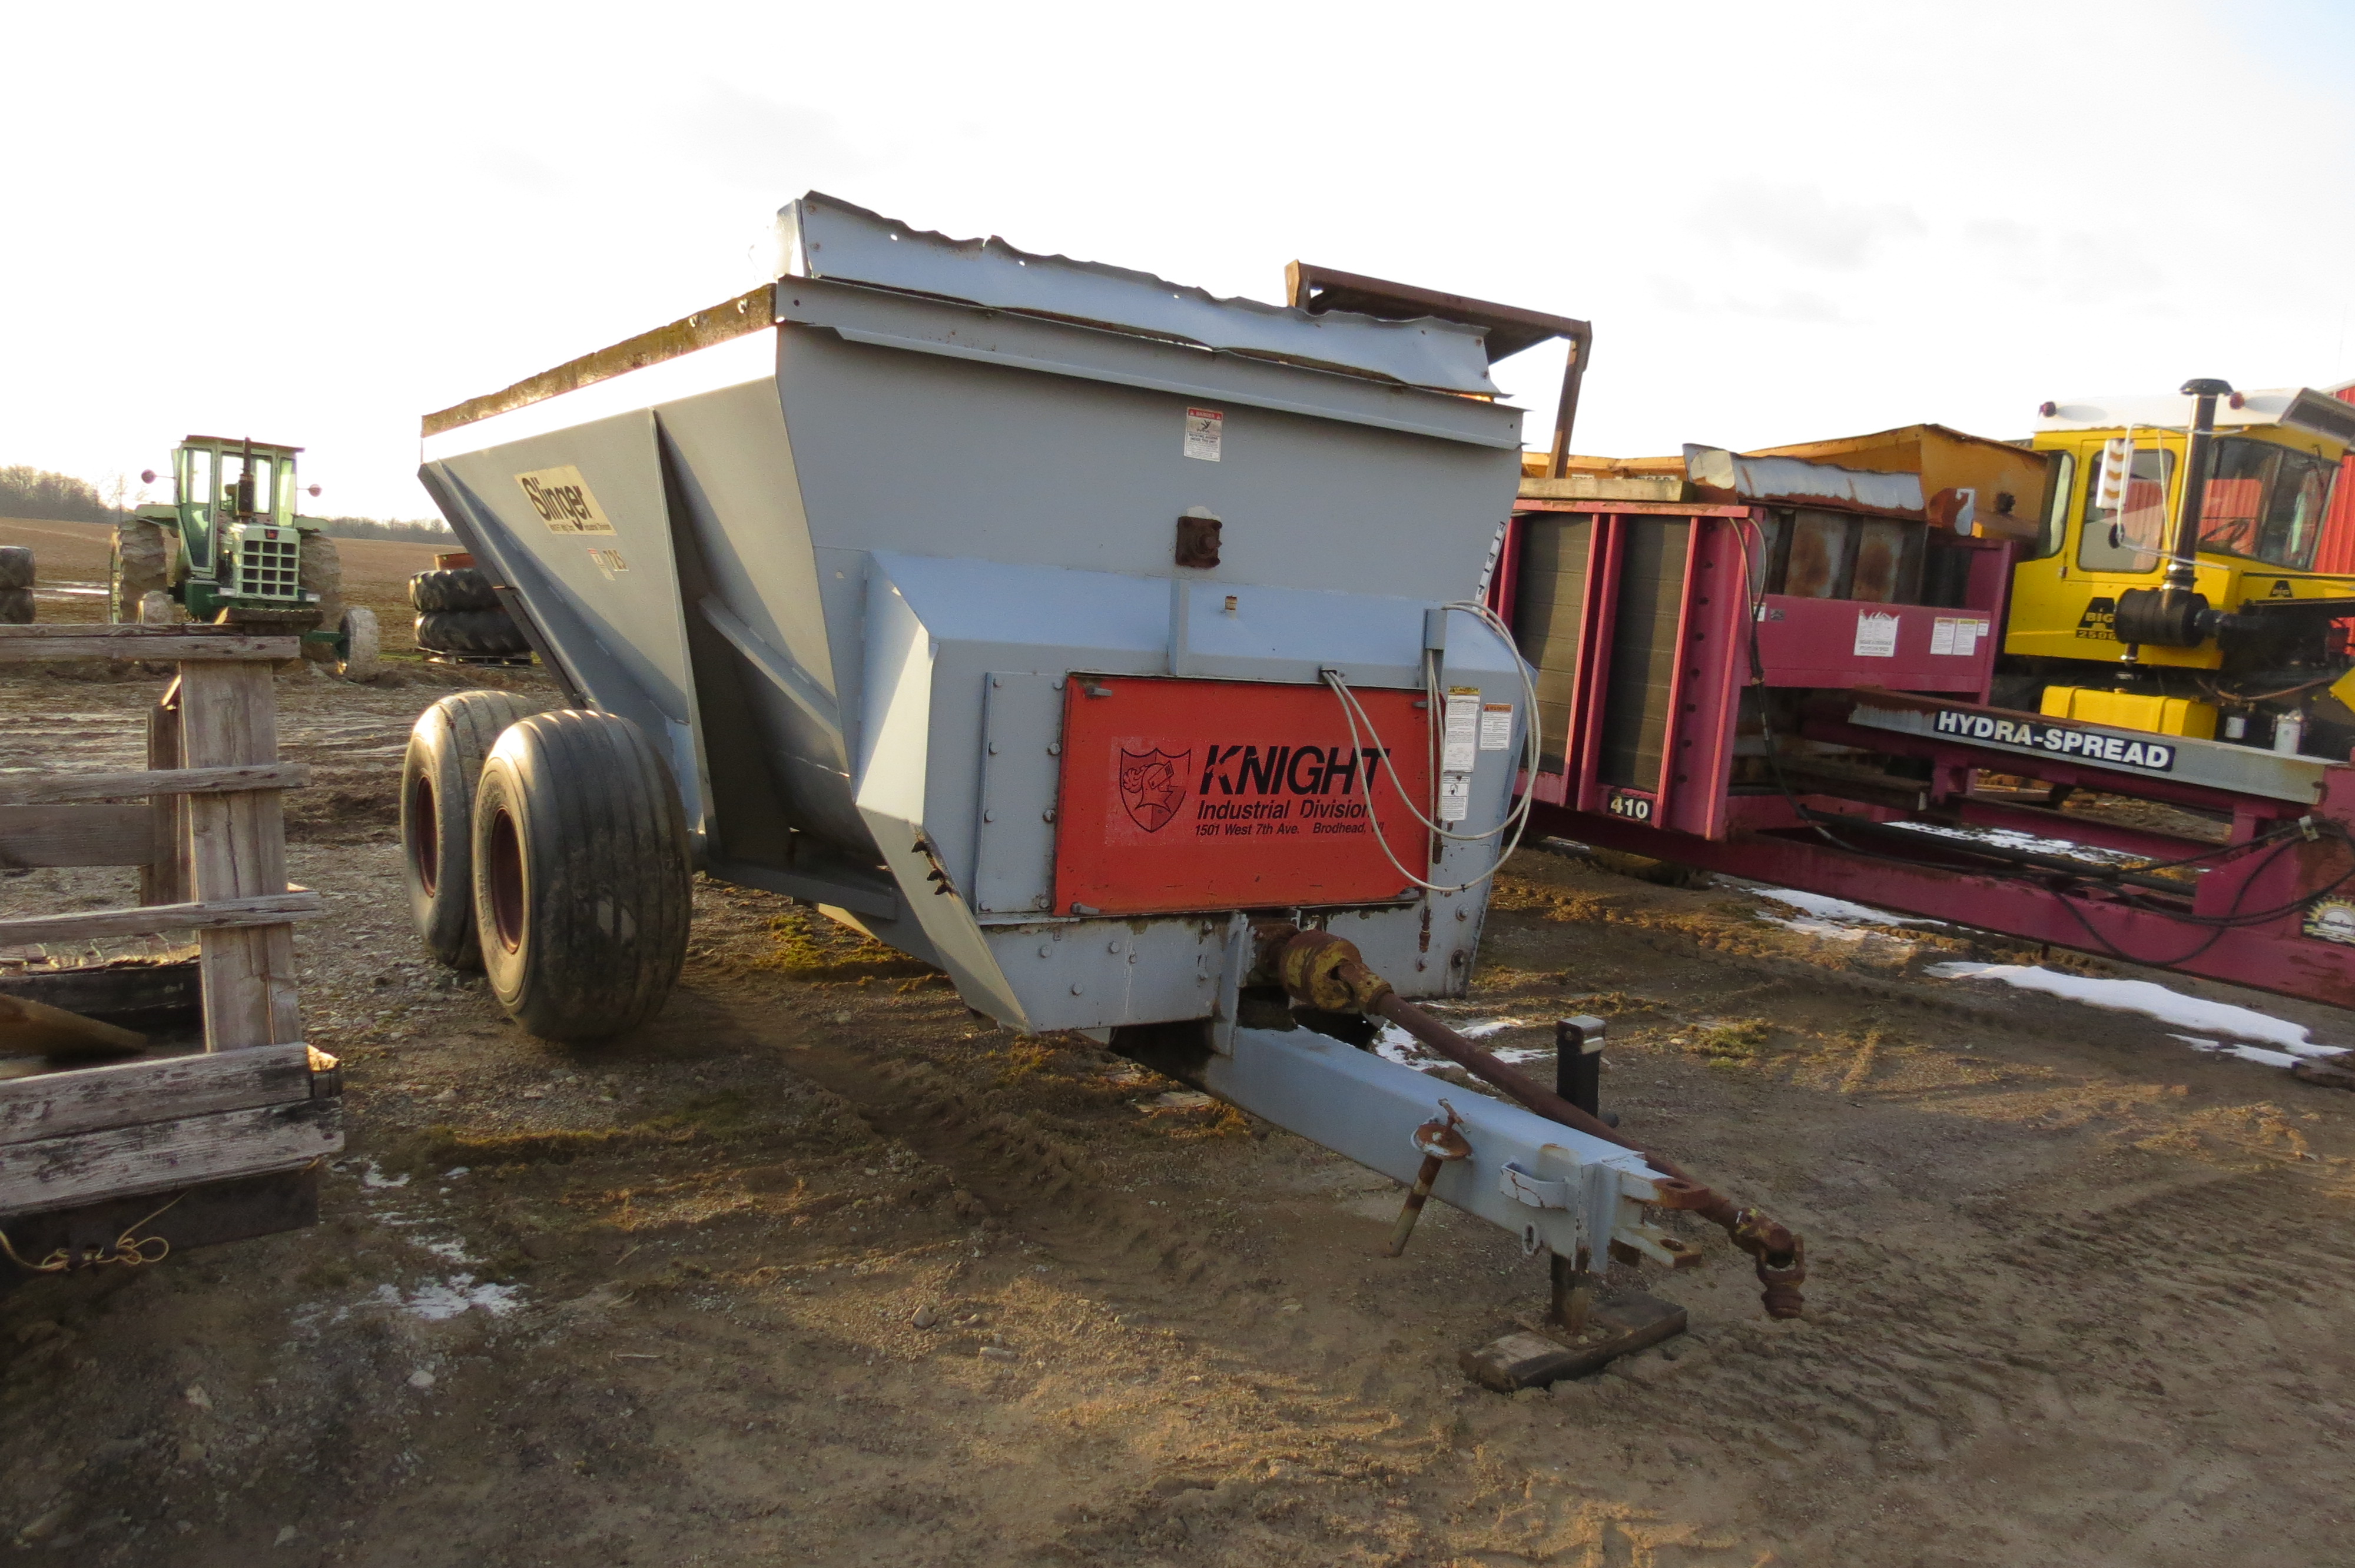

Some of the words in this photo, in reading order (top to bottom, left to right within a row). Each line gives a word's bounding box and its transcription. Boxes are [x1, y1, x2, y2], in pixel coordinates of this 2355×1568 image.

[522, 477, 593, 531] Slinger
[2085, 608, 2115, 623] BIG
[1938, 711, 2169, 768] HYDRA-SPREAD
[1199, 745, 1391, 795] KNIGHT
[1198, 800, 1291, 819] Industrial
[1610, 796, 1648, 819] 410
[1196, 824, 1219, 836] 1501
[1225, 824, 1252, 835] West
[1256, 823, 1273, 835] 7th
[1276, 824, 1299, 834] Ave.
[1313, 822, 1366, 834] Brodhead,
